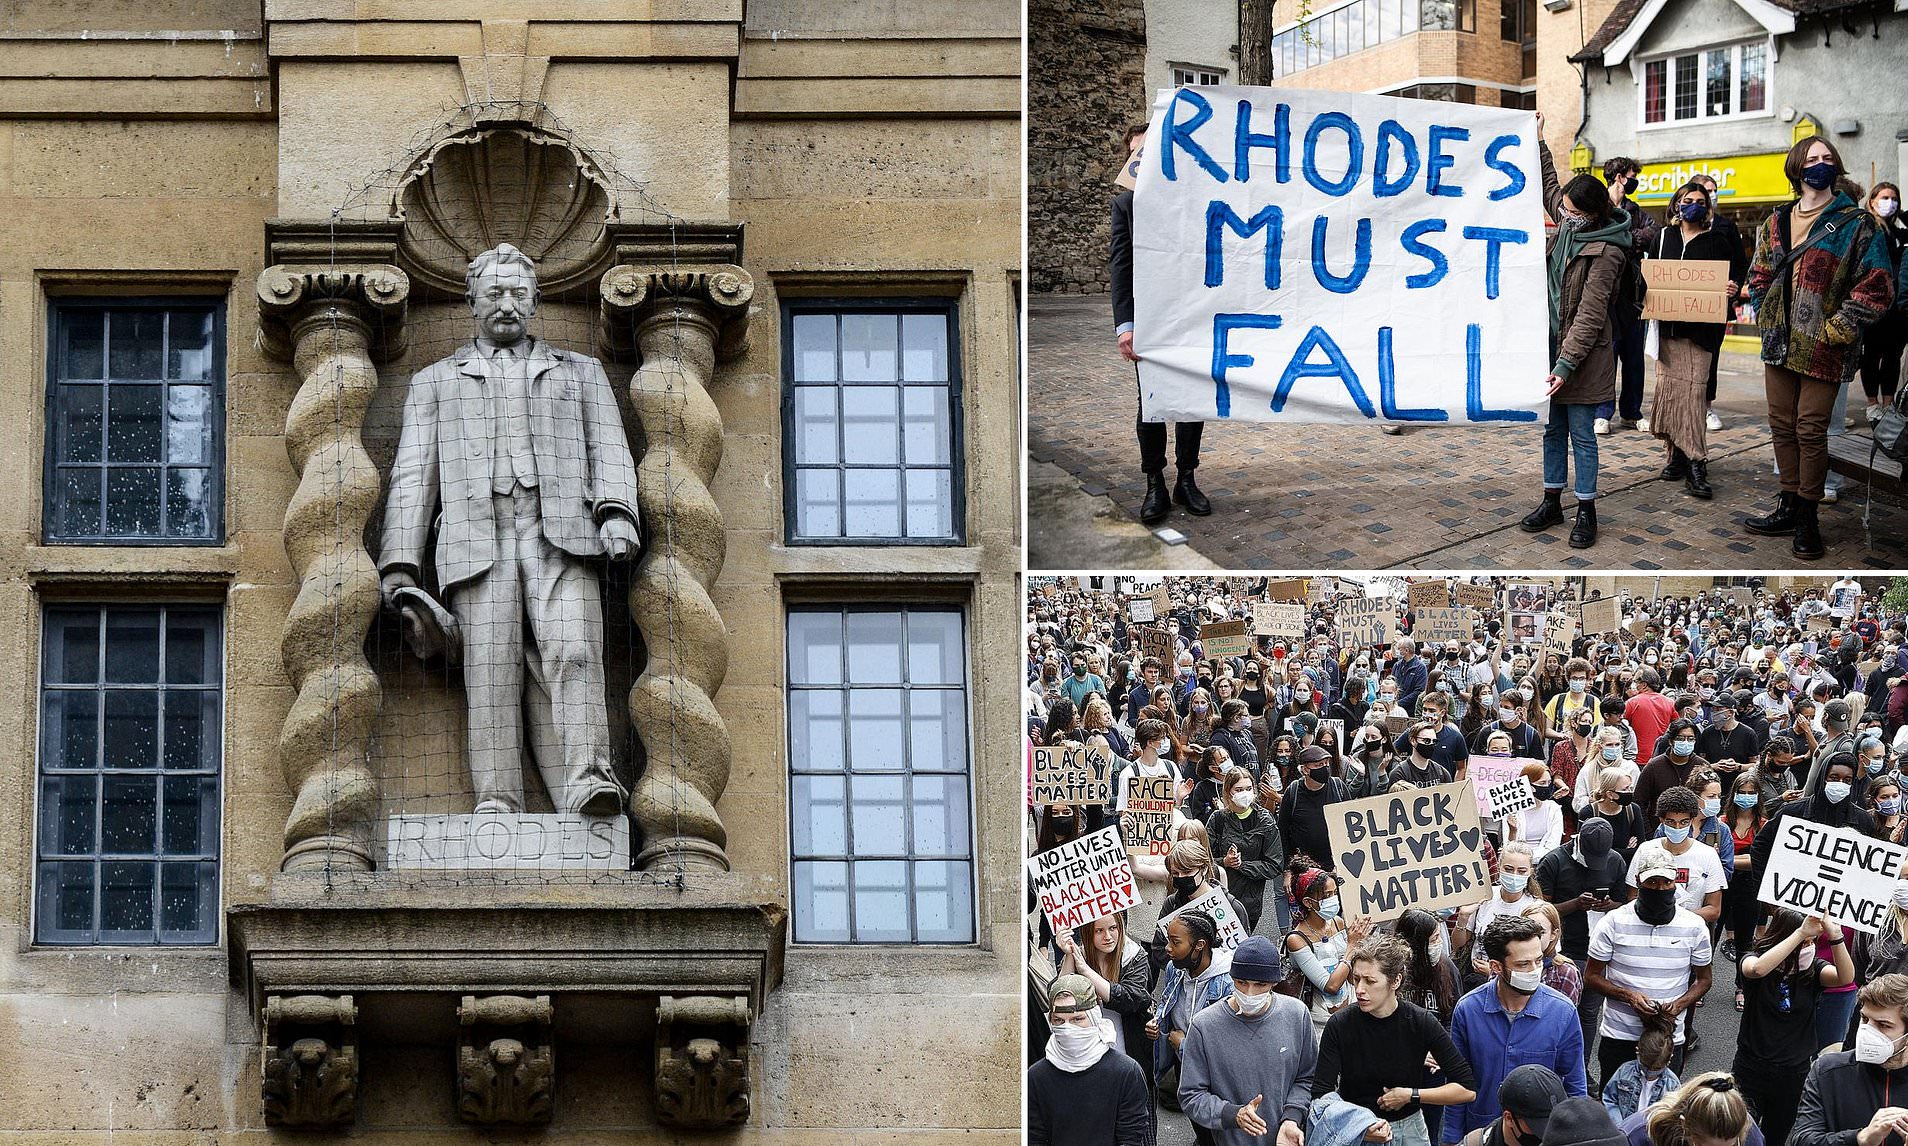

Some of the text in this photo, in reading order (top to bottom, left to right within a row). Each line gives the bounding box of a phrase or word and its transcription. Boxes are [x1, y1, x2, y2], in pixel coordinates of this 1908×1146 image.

[1161, 88, 1527, 201] RHODES
[1204, 200, 1530, 299] MUST
[1652, 265, 1716, 282] RHODES
[1645, 295, 1722, 313] WILL FALL!
[1211, 313, 1539, 422] FALL
[1121, 576, 1136, 584] NO
[1257, 609, 1300, 619] BLACK LIVES
[1340, 596, 1393, 615] RHODES
[1418, 608, 1469, 620] BLACK
[1223, 623, 1238, 633] UK
[1342, 614, 1375, 628] MUST
[1432, 621, 1459, 629] LIVES
[1546, 615, 1566, 630] AKE
[1208, 636, 1234, 646] IS NOT
[1341, 629, 1376, 649] FALL
[1417, 629, 1469, 640] MATTER
[1145, 646, 1167, 659] IS A
[1209, 645, 1246, 655] INNOCENT
[1545, 637, 1567, 652] OWN
[1035, 748, 1097, 772] BLACK
[1035, 771, 1087, 785] LIVES
[1035, 783, 1108, 801] MATTER
[1128, 778, 1174, 800] RACE
[1489, 779, 1525, 798] BLACK
[1493, 788, 1527, 806] LIVES
[1492, 797, 1535, 819] MATTER
[1344, 792, 1455, 844] BLACK
[1127, 822, 1173, 842] BLACK
[403, 821, 615, 863] RHODES
[1038, 830, 1114, 873] NO LIVES
[1149, 840, 1171, 856] DO
[1371, 824, 1460, 871] LIVES
[1784, 825, 1902, 879] SILENCE
[1035, 846, 1127, 893] MATTER UNTIL
[1041, 863, 1131, 914] BLACK LIVES
[1360, 861, 1485, 914] MATTER!
[1051, 883, 1134, 934] MATTER!
[1195, 895, 1222, 912] TICE,
[1774, 872, 1887, 929] VIOLENCE
